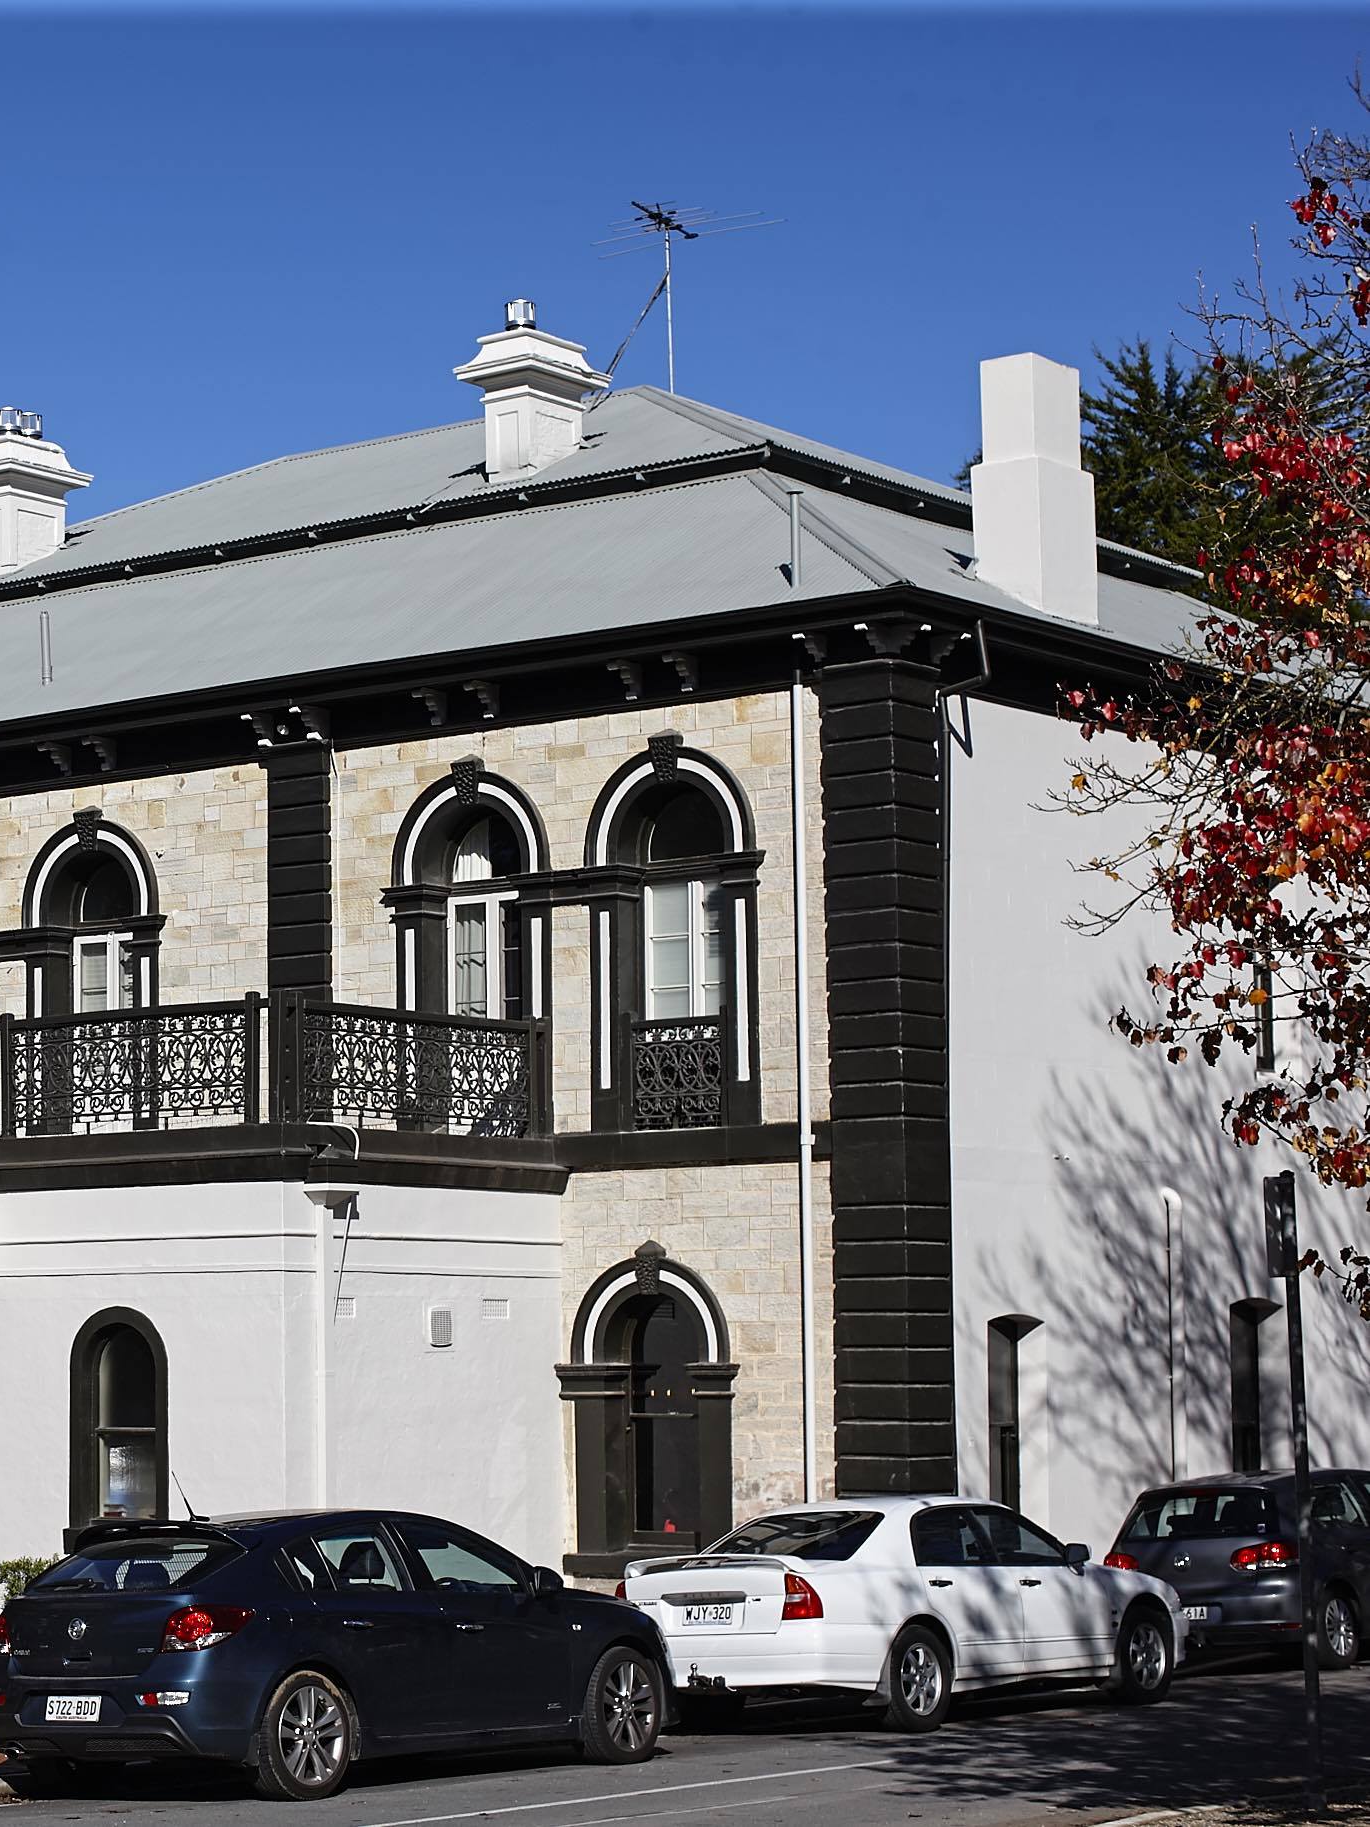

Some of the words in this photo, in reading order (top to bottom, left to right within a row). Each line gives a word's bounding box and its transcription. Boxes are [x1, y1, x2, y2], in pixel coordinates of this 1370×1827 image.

[686, 1607, 708, 1621] WJY
[712, 1606, 731, 1620] 320
[48, 1700, 97, 1716] S722-BDD
